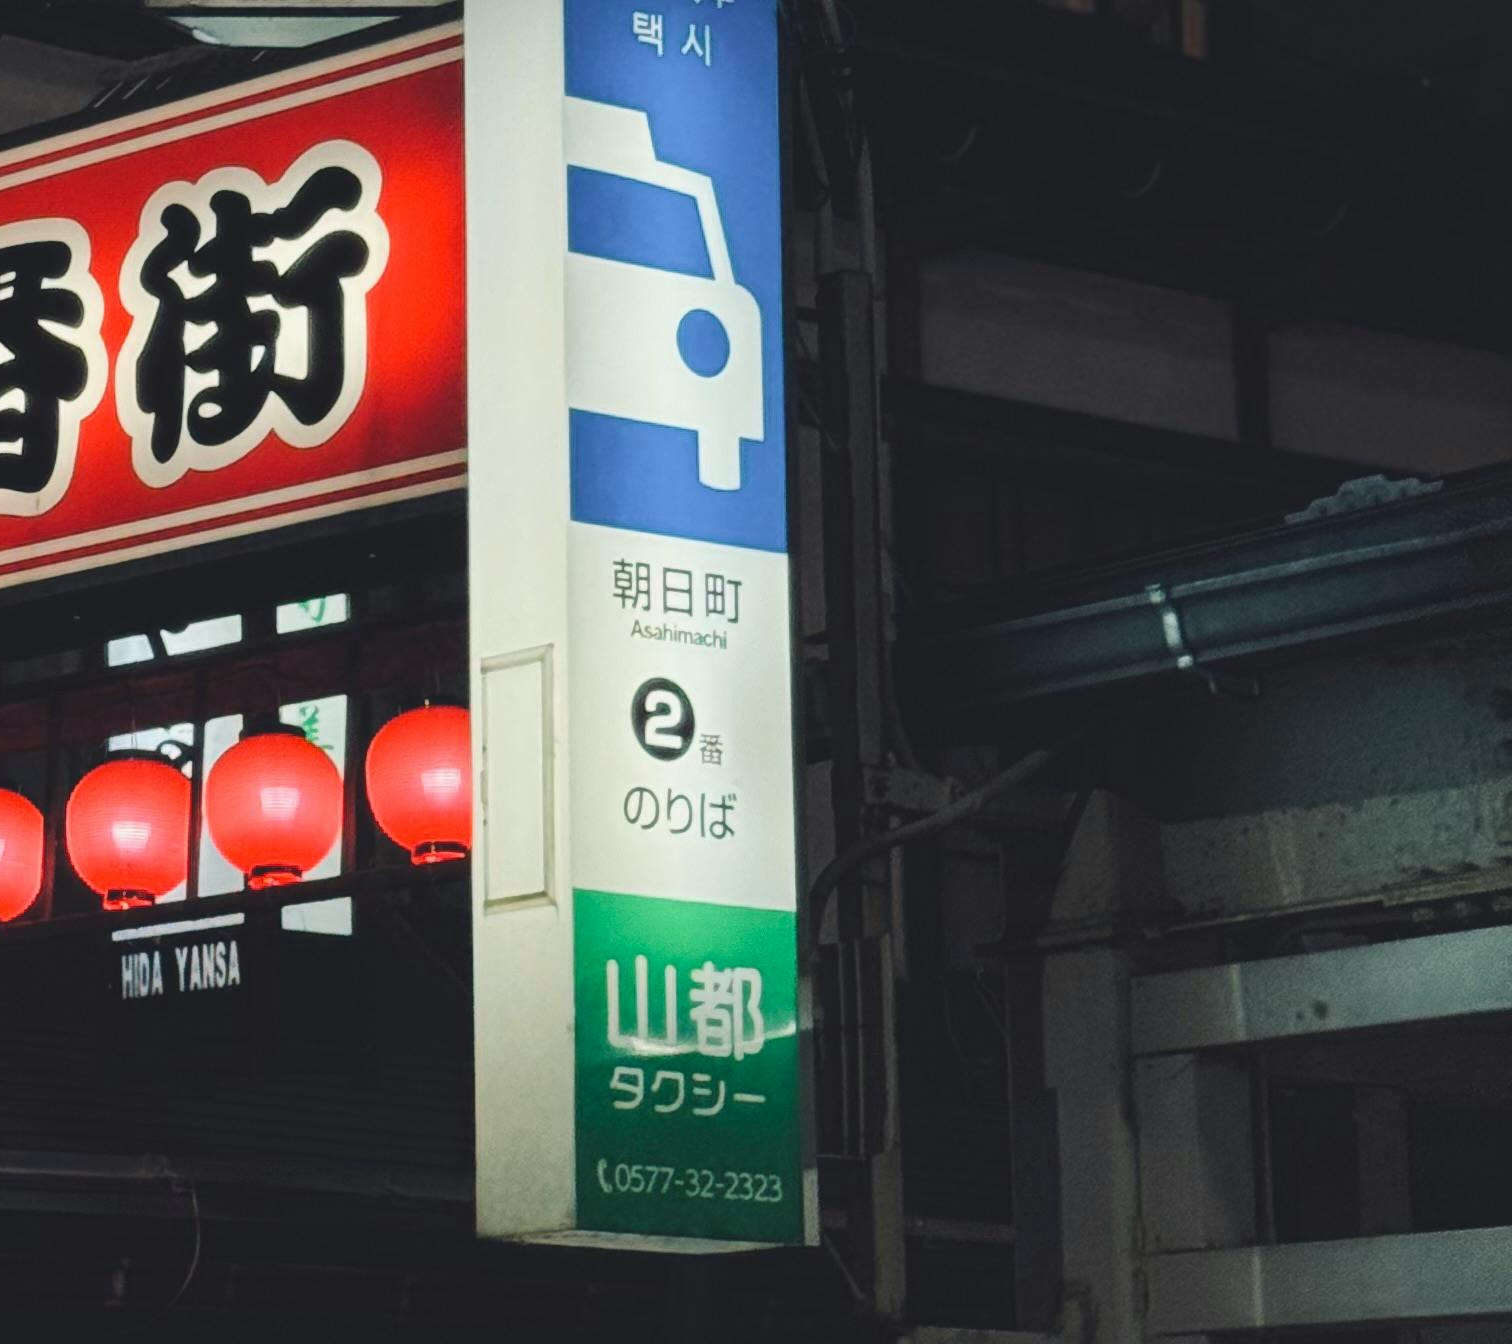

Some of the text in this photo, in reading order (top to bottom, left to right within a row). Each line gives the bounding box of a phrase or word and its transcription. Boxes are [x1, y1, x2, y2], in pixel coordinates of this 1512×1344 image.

[612, 558, 743, 625] 朝日町
[630, 619, 728, 651] Asahimachi
[623, 786, 737, 840] のりば
[121, 940, 240, 1000] HIDA YANSA
[606, 954, 765, 1061] 山都
[609, 1066, 767, 1116] タクシー
[614, 1162, 784, 1204] 0577-32-2323
